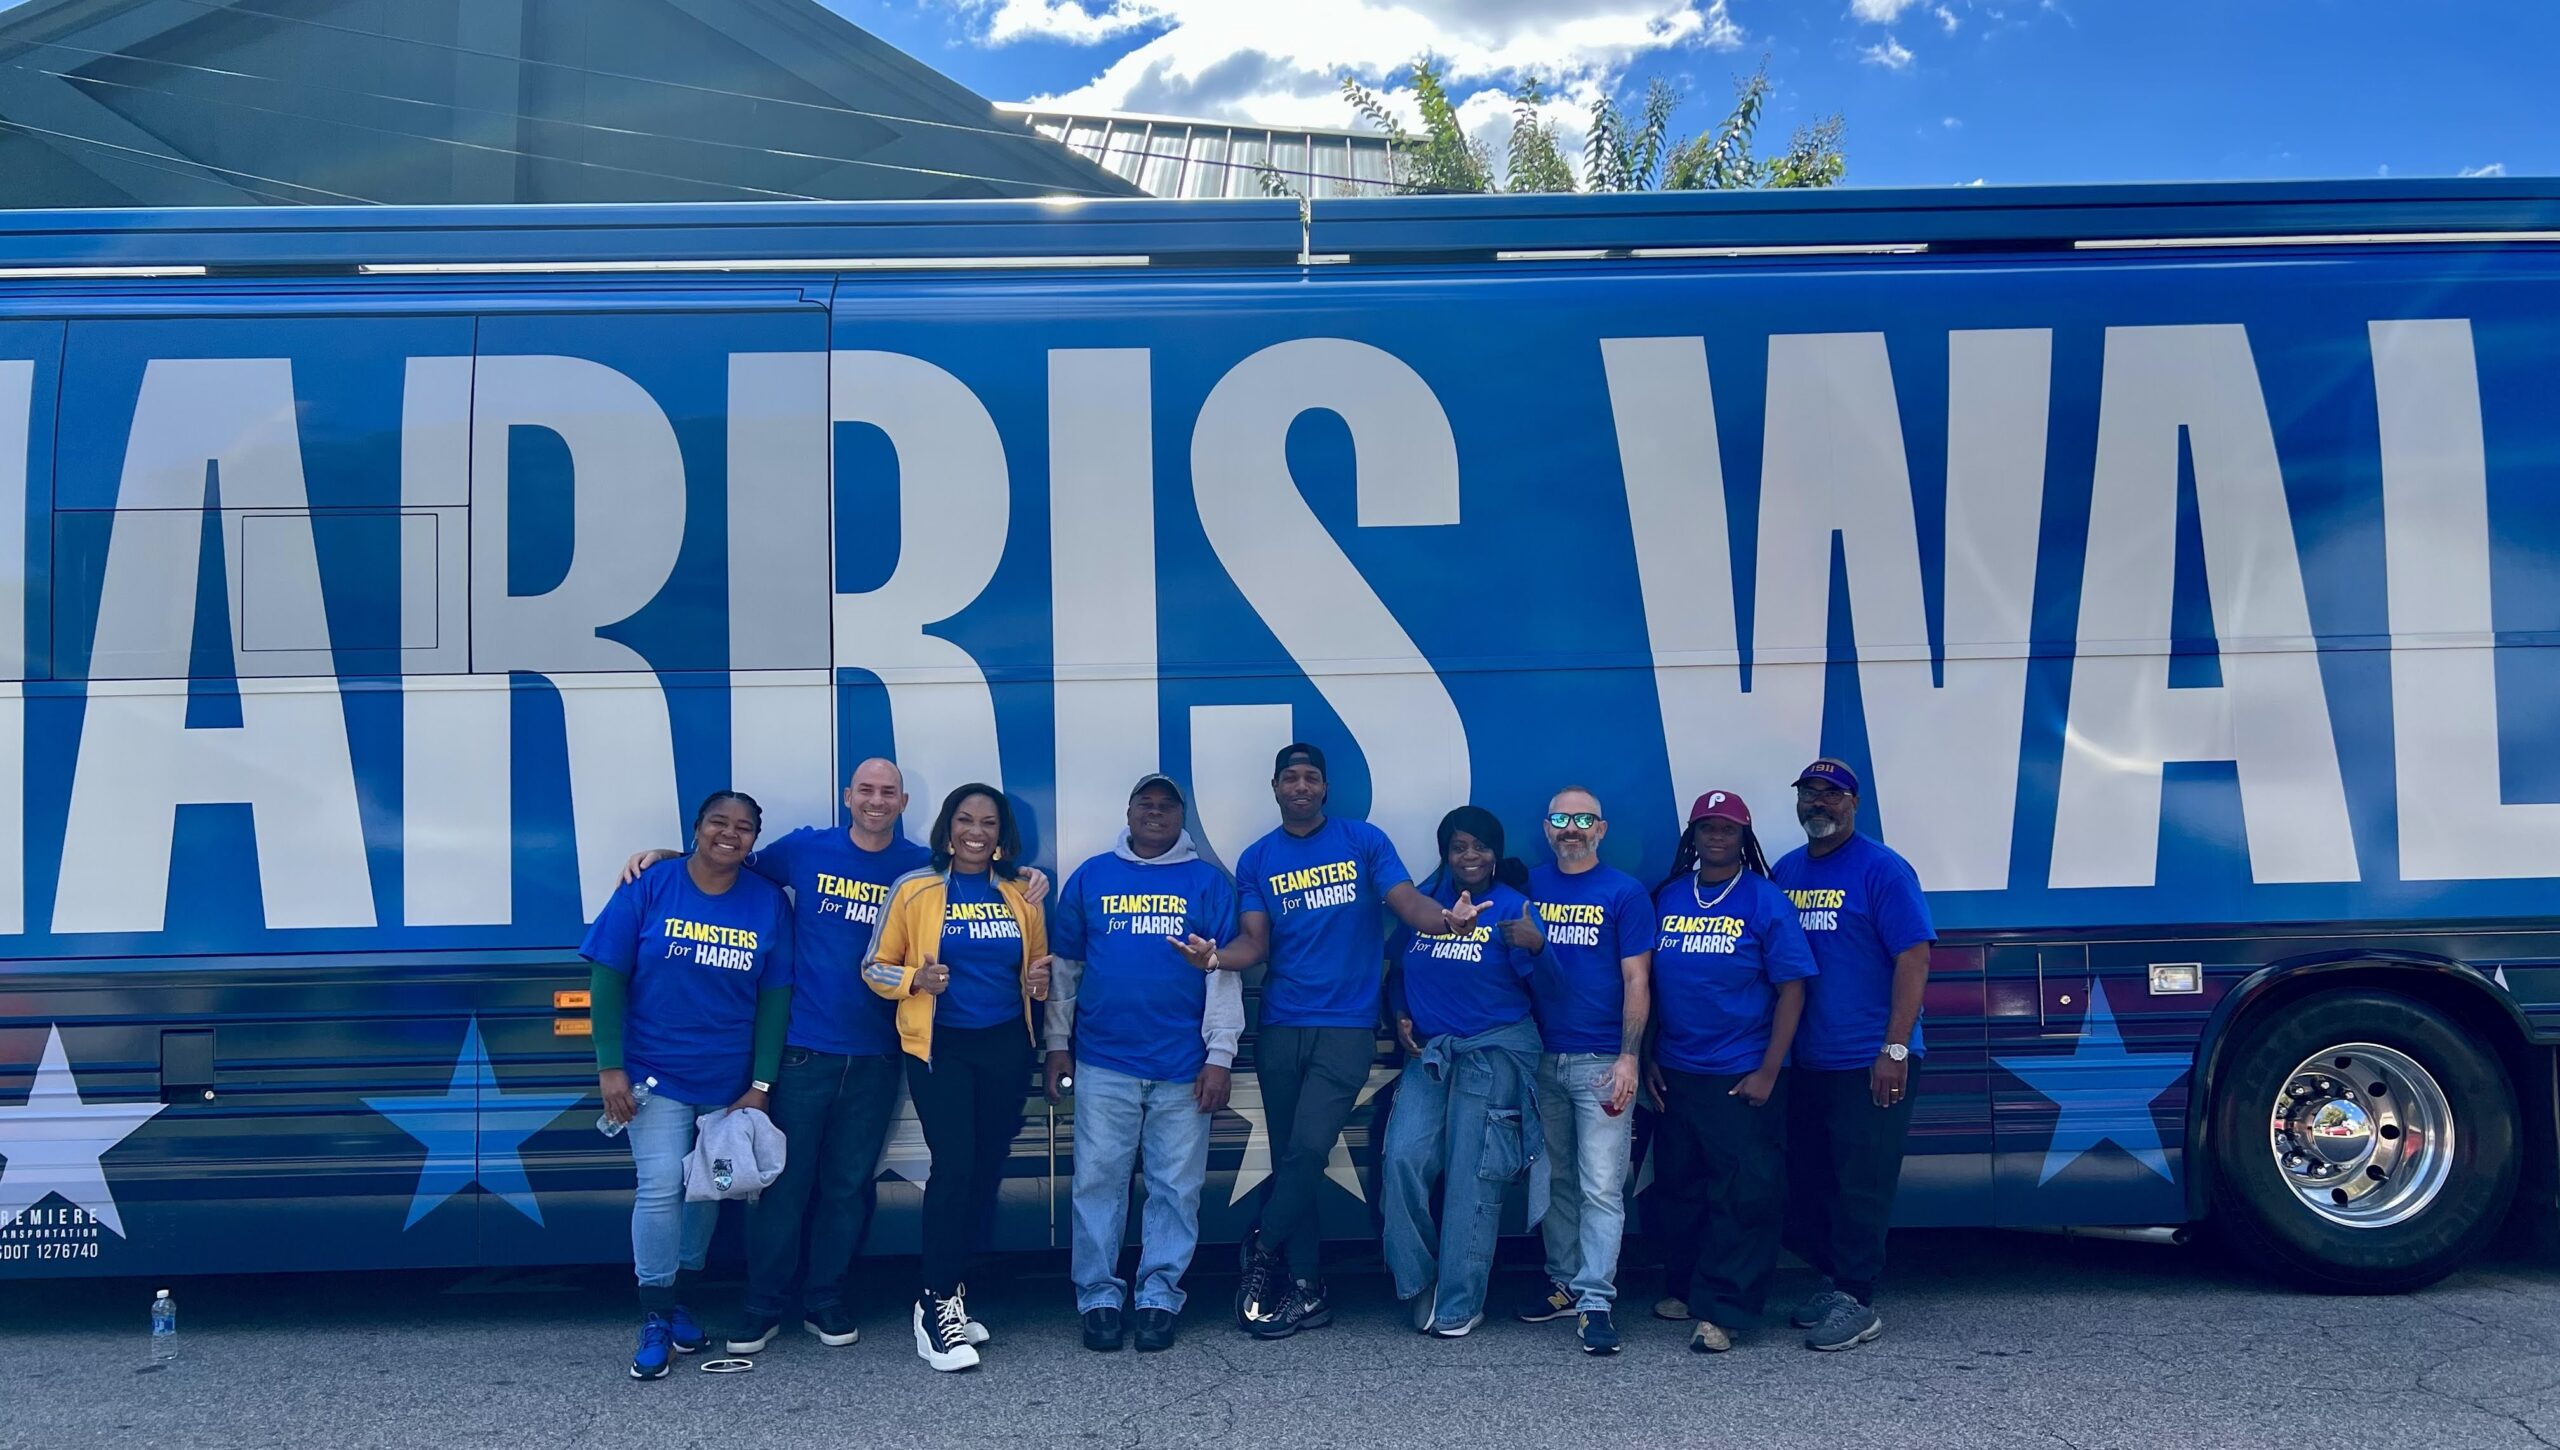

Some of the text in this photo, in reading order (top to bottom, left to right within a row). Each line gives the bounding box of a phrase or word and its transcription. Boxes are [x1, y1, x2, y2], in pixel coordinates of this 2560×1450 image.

[1810, 763, 1835, 773] 1911
[1708, 792, 1726, 809] P
[1268, 860, 1358, 896] TEAMSTERS
[817, 898, 843, 914] for
[1101, 894, 1188, 914] TEAMSTERS
[1282, 883, 1357, 915] for HARRIS
[1782, 889, 1846, 909] AMSTERS
[1533, 901, 1605, 925] AMSTERS
[664, 917, 758, 950] TEAMSTERS
[941, 920, 1021, 939] for HARRIS
[1106, 915, 1184, 936] for HARRIS
[1547, 924, 1600, 946] HARRIS
[1409, 939, 1483, 963] for HARRIS
[1657, 934, 1737, 954] for HARRIS
[664, 941, 754, 971] for HARRIS
[0, 1243, 98, 1260] DOT 1276740
